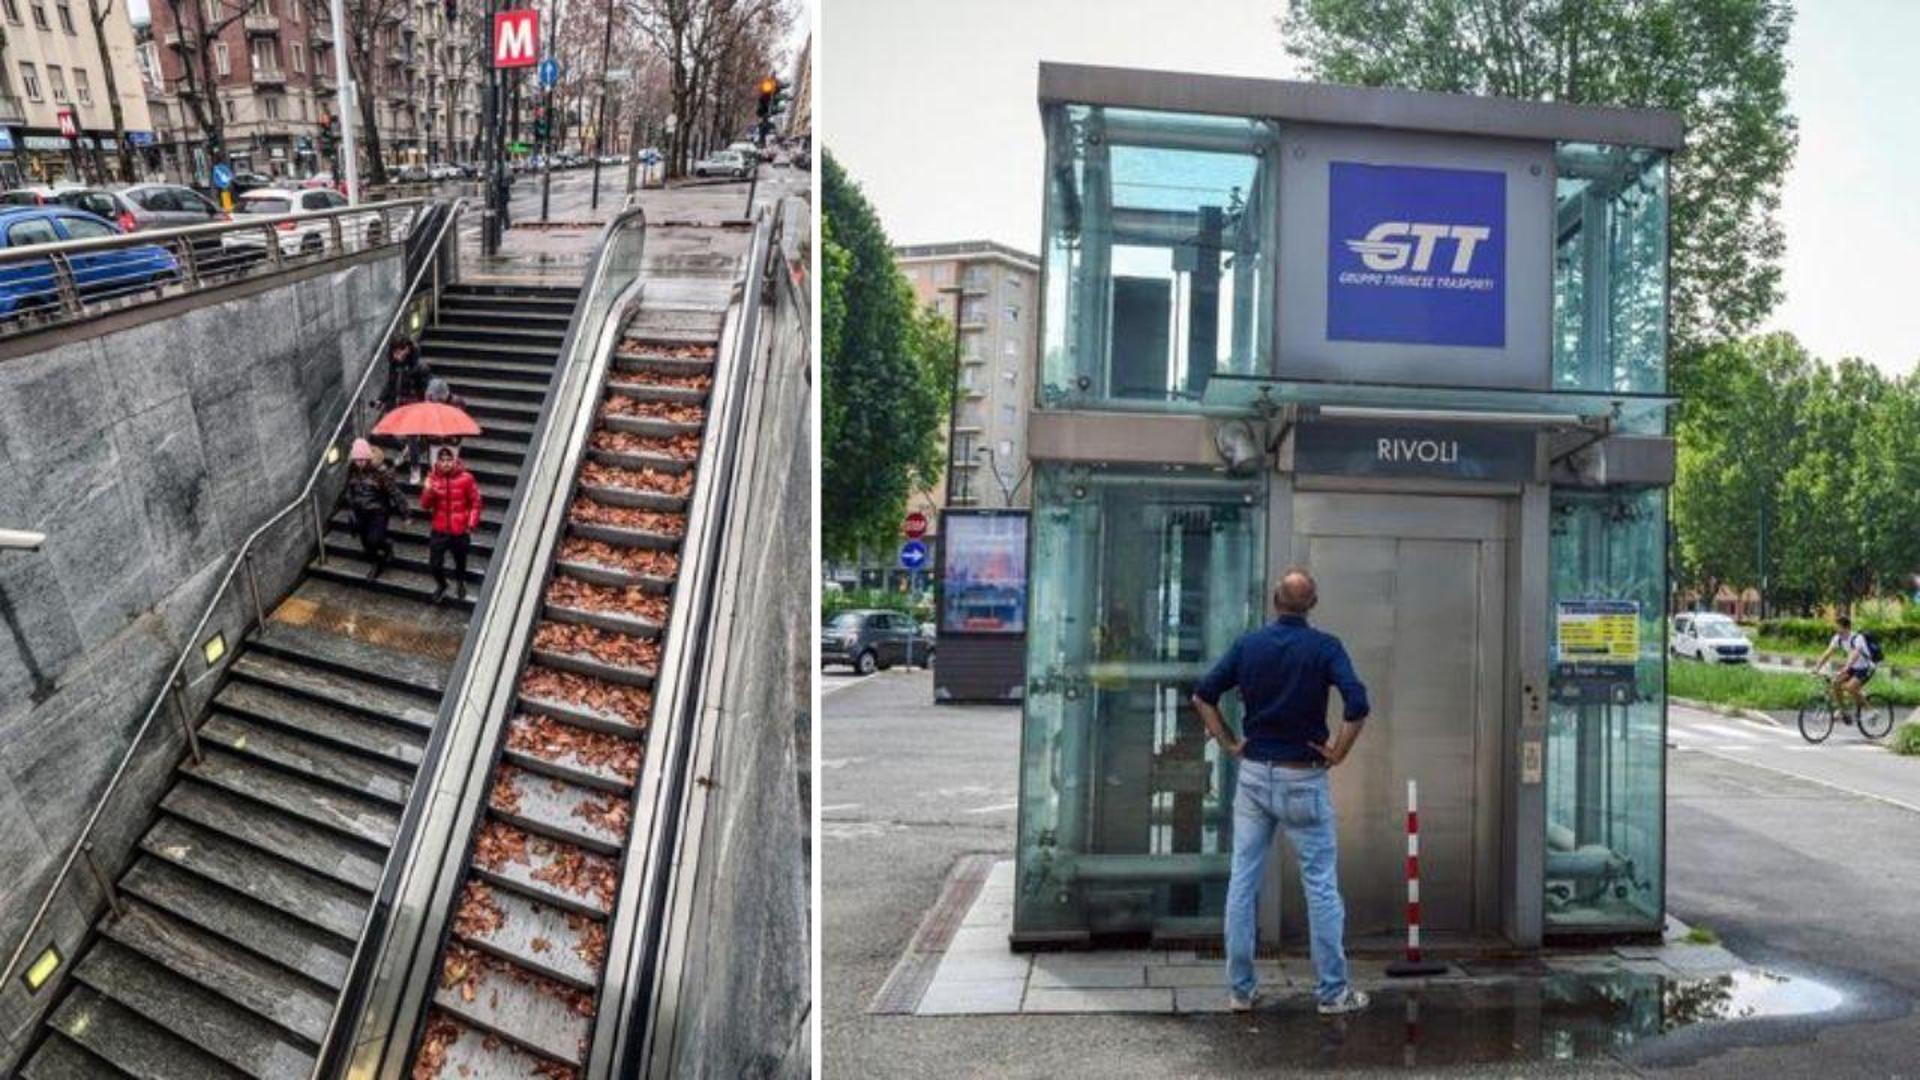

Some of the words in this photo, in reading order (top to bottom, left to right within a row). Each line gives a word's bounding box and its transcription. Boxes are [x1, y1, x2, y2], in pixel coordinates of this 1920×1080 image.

[497, 18, 534, 60] M
[60, 114, 76, 136] M
[1345, 222, 1491, 273] GTT
[1338, 271, 1383, 286] GRUPPO
[1384, 273, 1434, 288] TORINESE
[1436, 276, 1494, 291] TRASPORTI
[1376, 437, 1459, 463] RIVOLI
